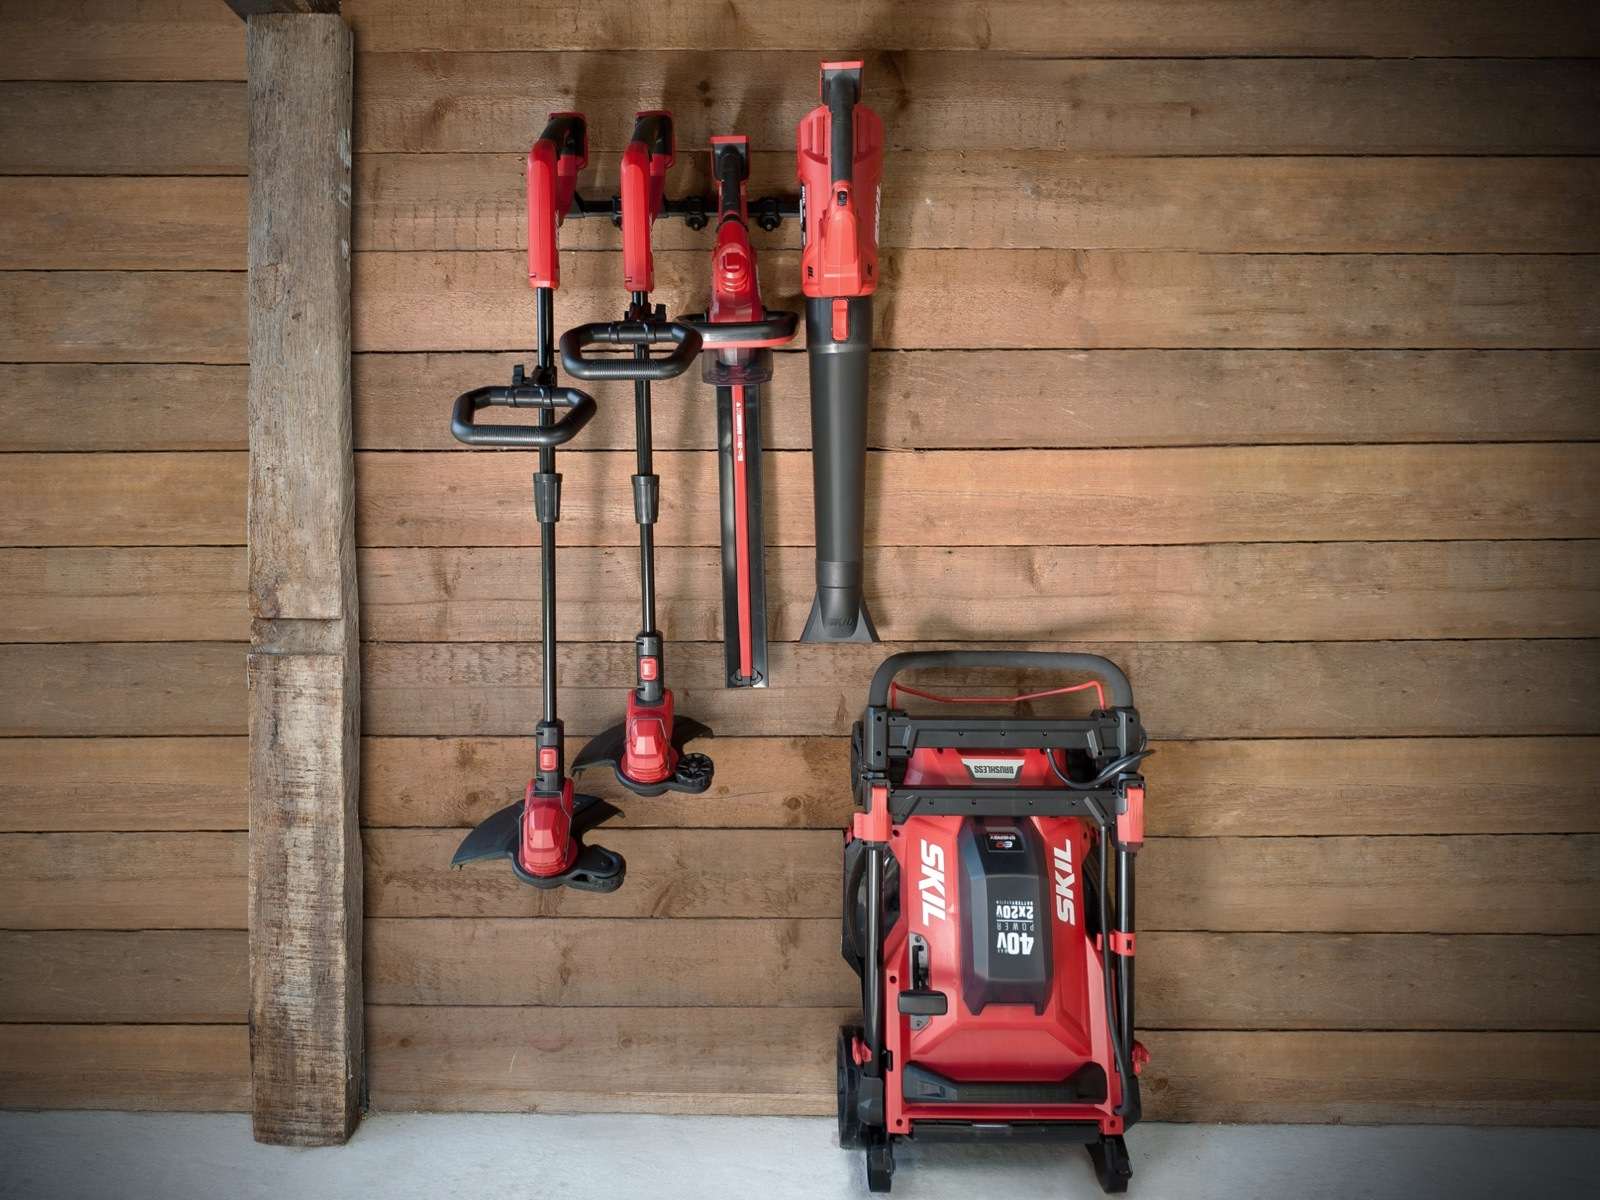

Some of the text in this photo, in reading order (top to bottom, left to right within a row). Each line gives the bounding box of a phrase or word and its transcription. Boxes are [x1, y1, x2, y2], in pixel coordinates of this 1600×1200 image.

[974, 765, 1014, 774] BRUSHLESS
[918, 839, 946, 927] SKIL
[1054, 839, 1076, 926] SKIL
[996, 922, 1034, 931] POWER
